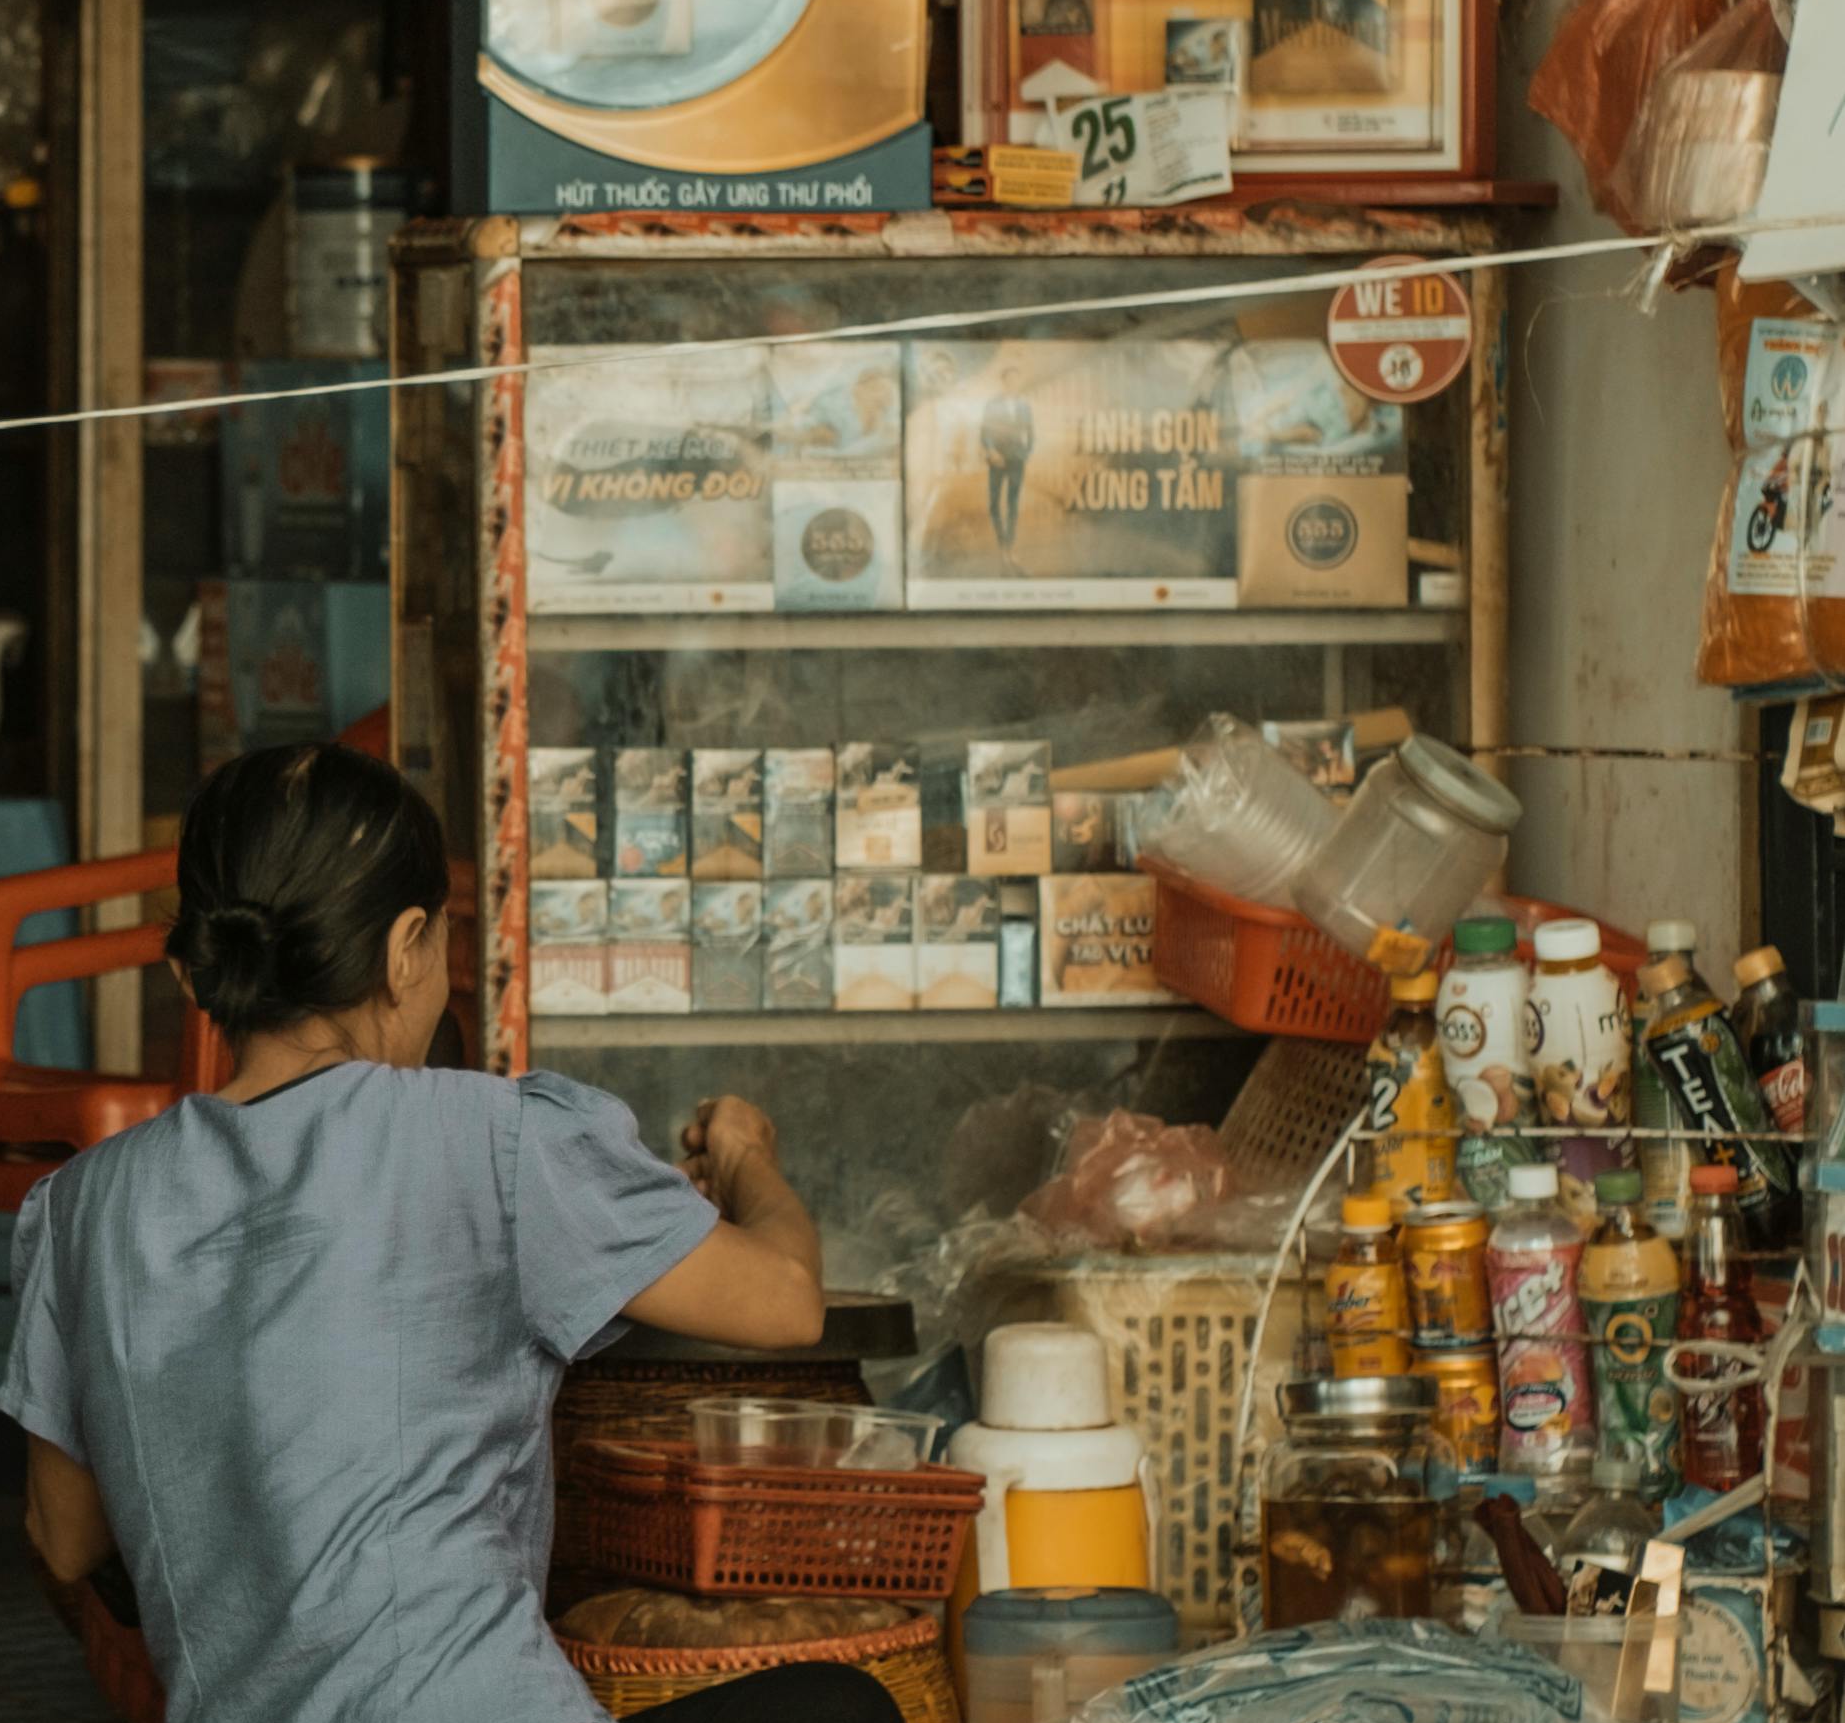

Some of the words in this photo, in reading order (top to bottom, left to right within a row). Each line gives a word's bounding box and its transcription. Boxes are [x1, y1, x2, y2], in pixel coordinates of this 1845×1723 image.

[1071, 95, 1138, 182] 25
[726, 183, 770, 206] UNG
[1354, 279, 1404, 317] WE
[1412, 277, 1445, 314] ID
